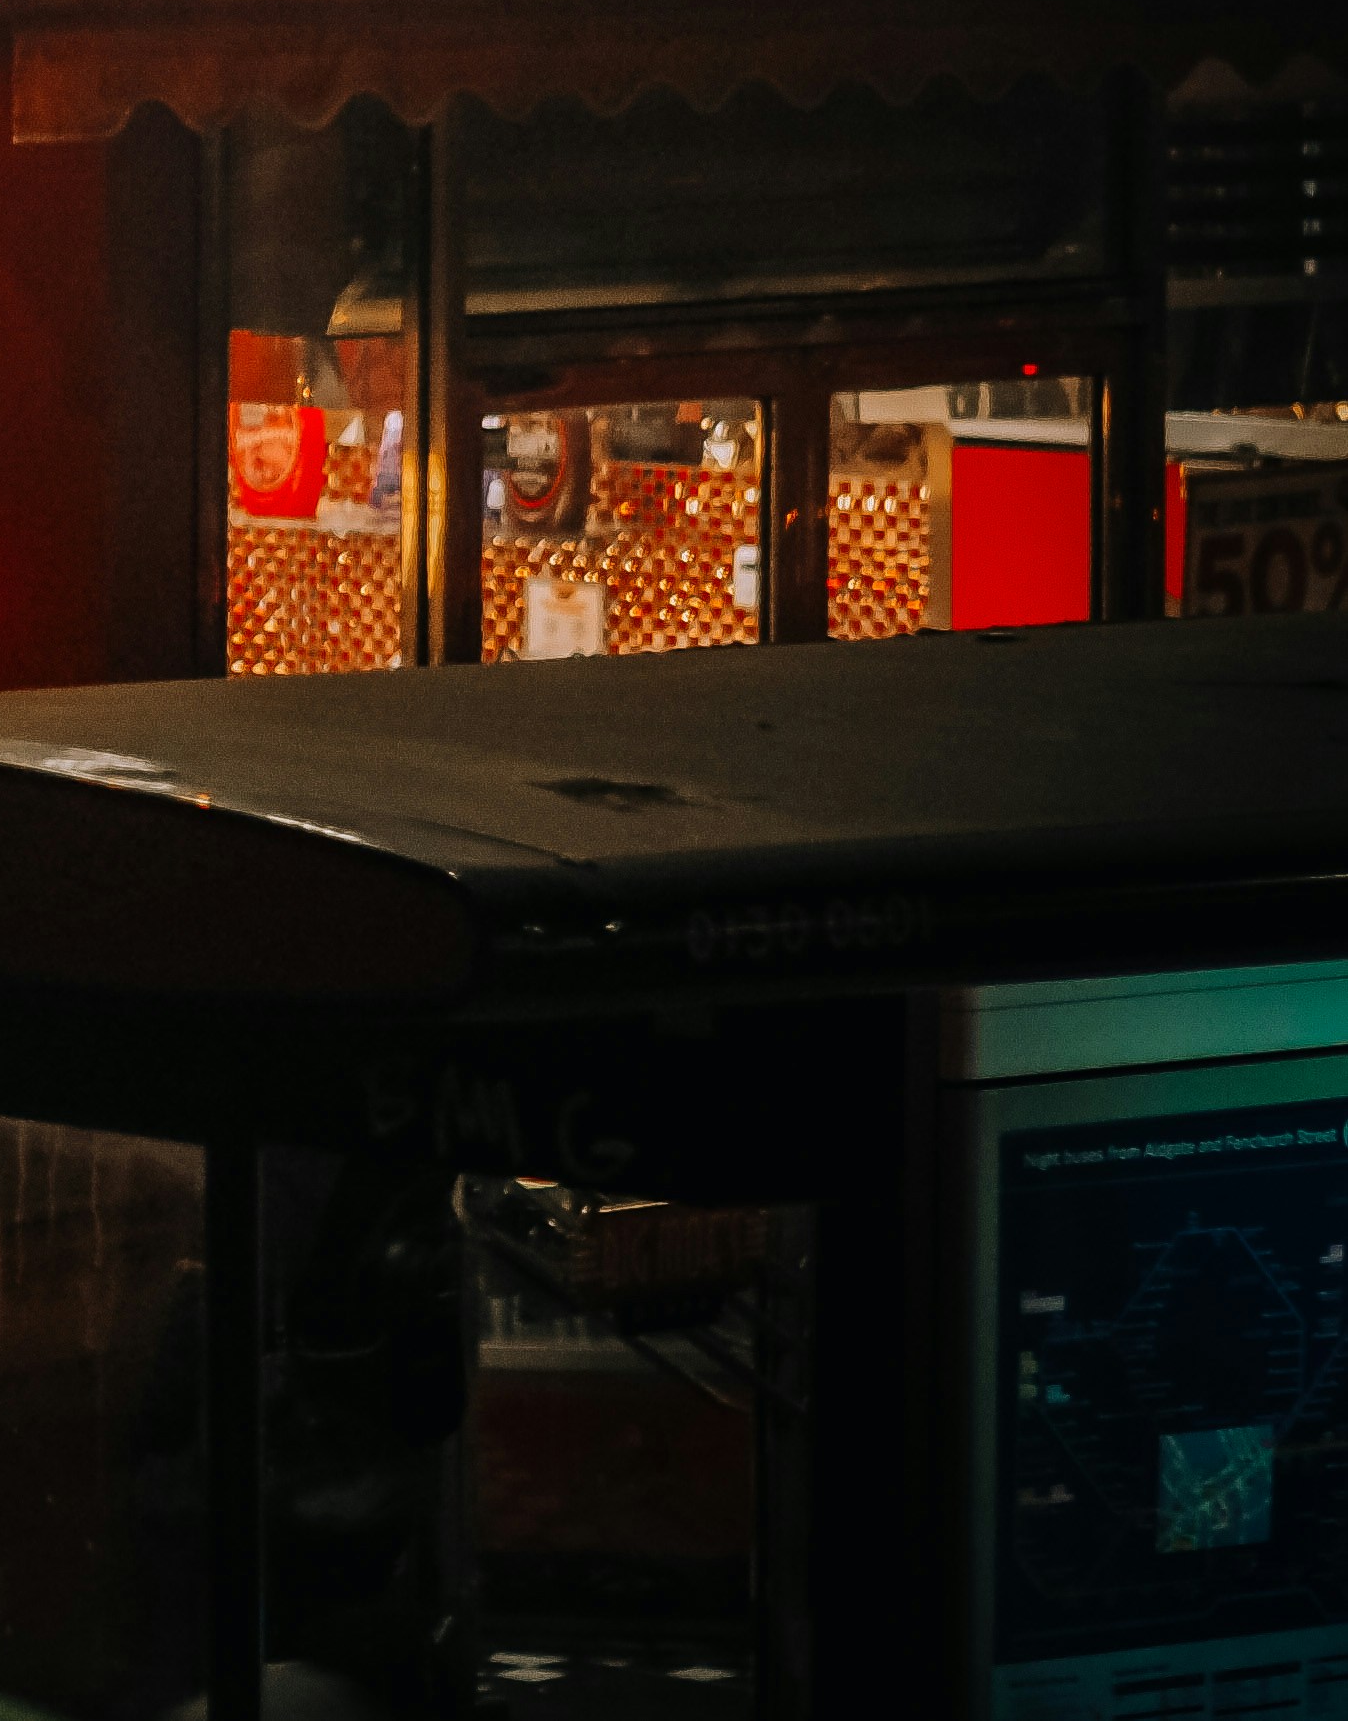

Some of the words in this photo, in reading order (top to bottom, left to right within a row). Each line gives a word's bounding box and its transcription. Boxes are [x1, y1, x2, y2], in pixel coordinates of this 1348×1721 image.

[1023, 1151, 1060, 1171] Night
[1107, 1144, 1141, 1160] from
[1144, 1141, 1196, 1160] Aldgate
[1199, 1139, 1222, 1153] and
[1226, 1134, 1294, 1151] Fenchurch
[1297, 1128, 1338, 1145] Street
